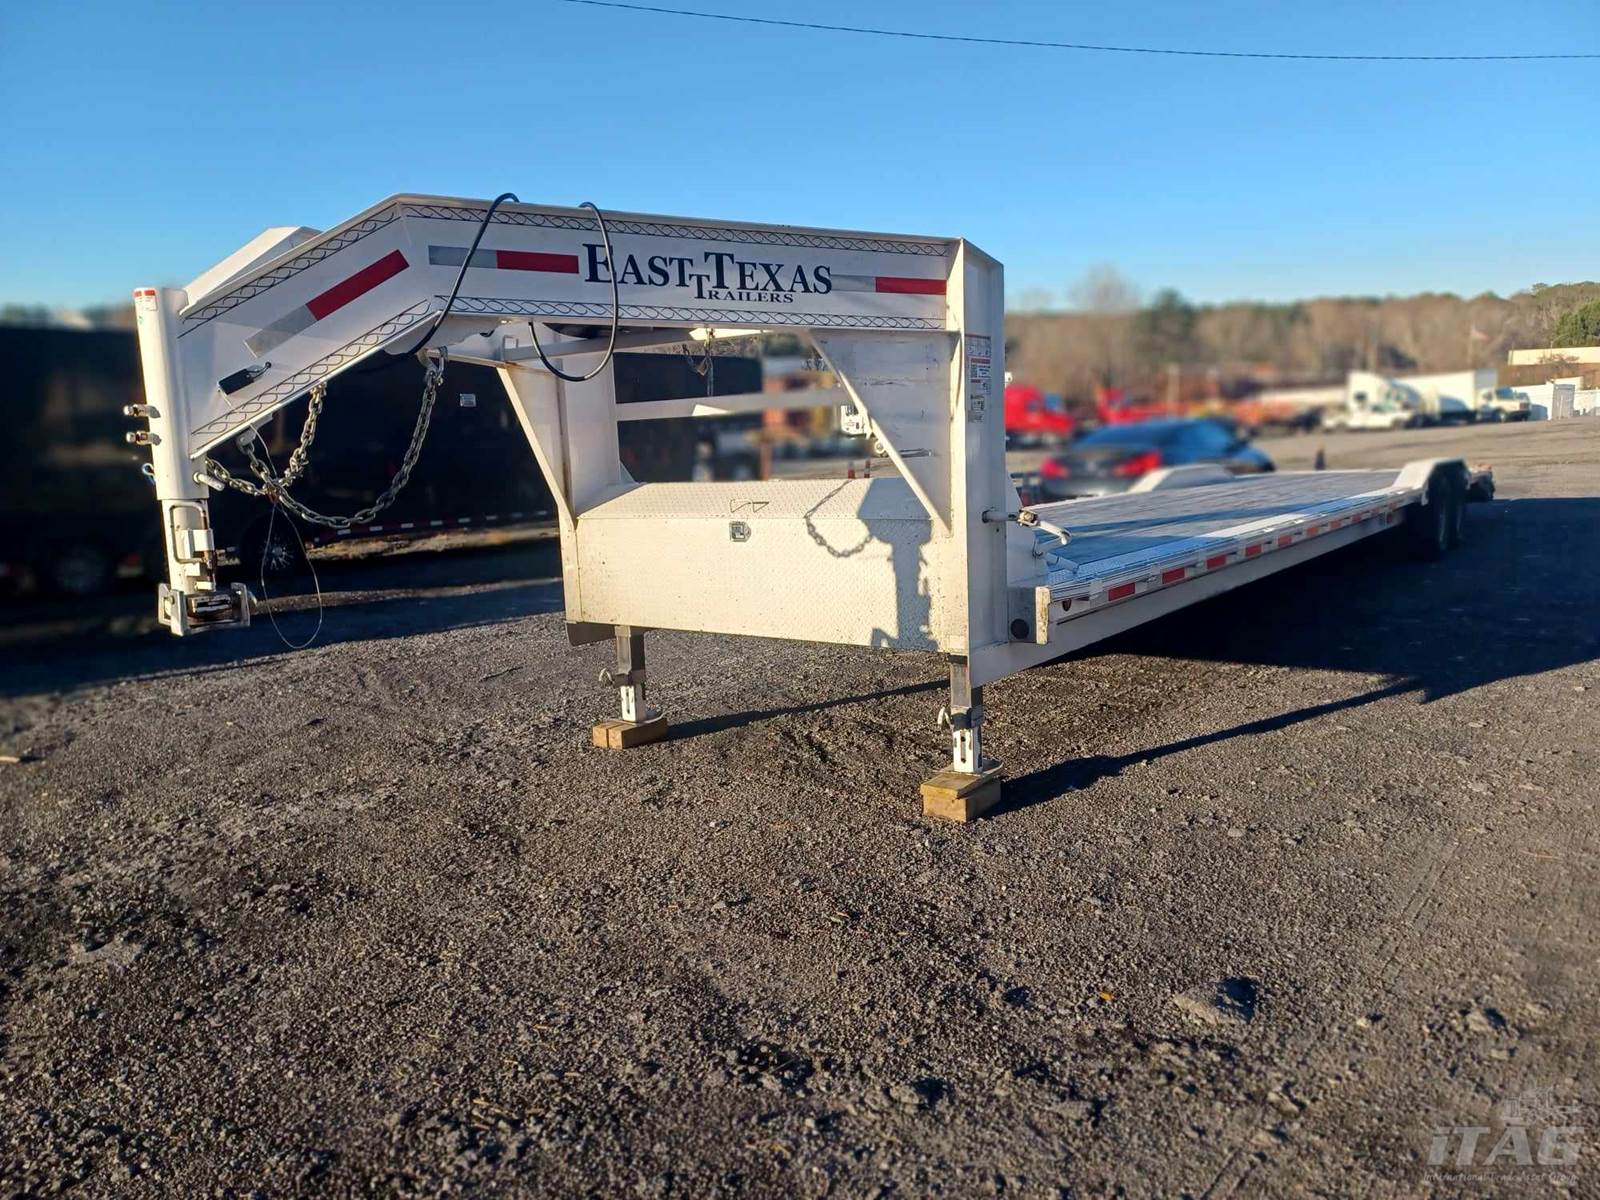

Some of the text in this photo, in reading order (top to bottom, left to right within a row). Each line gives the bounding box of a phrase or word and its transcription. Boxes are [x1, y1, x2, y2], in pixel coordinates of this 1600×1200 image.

[582, 243, 832, 295] EAST TEXAS
[689, 273, 794, 304] TRAILERS
